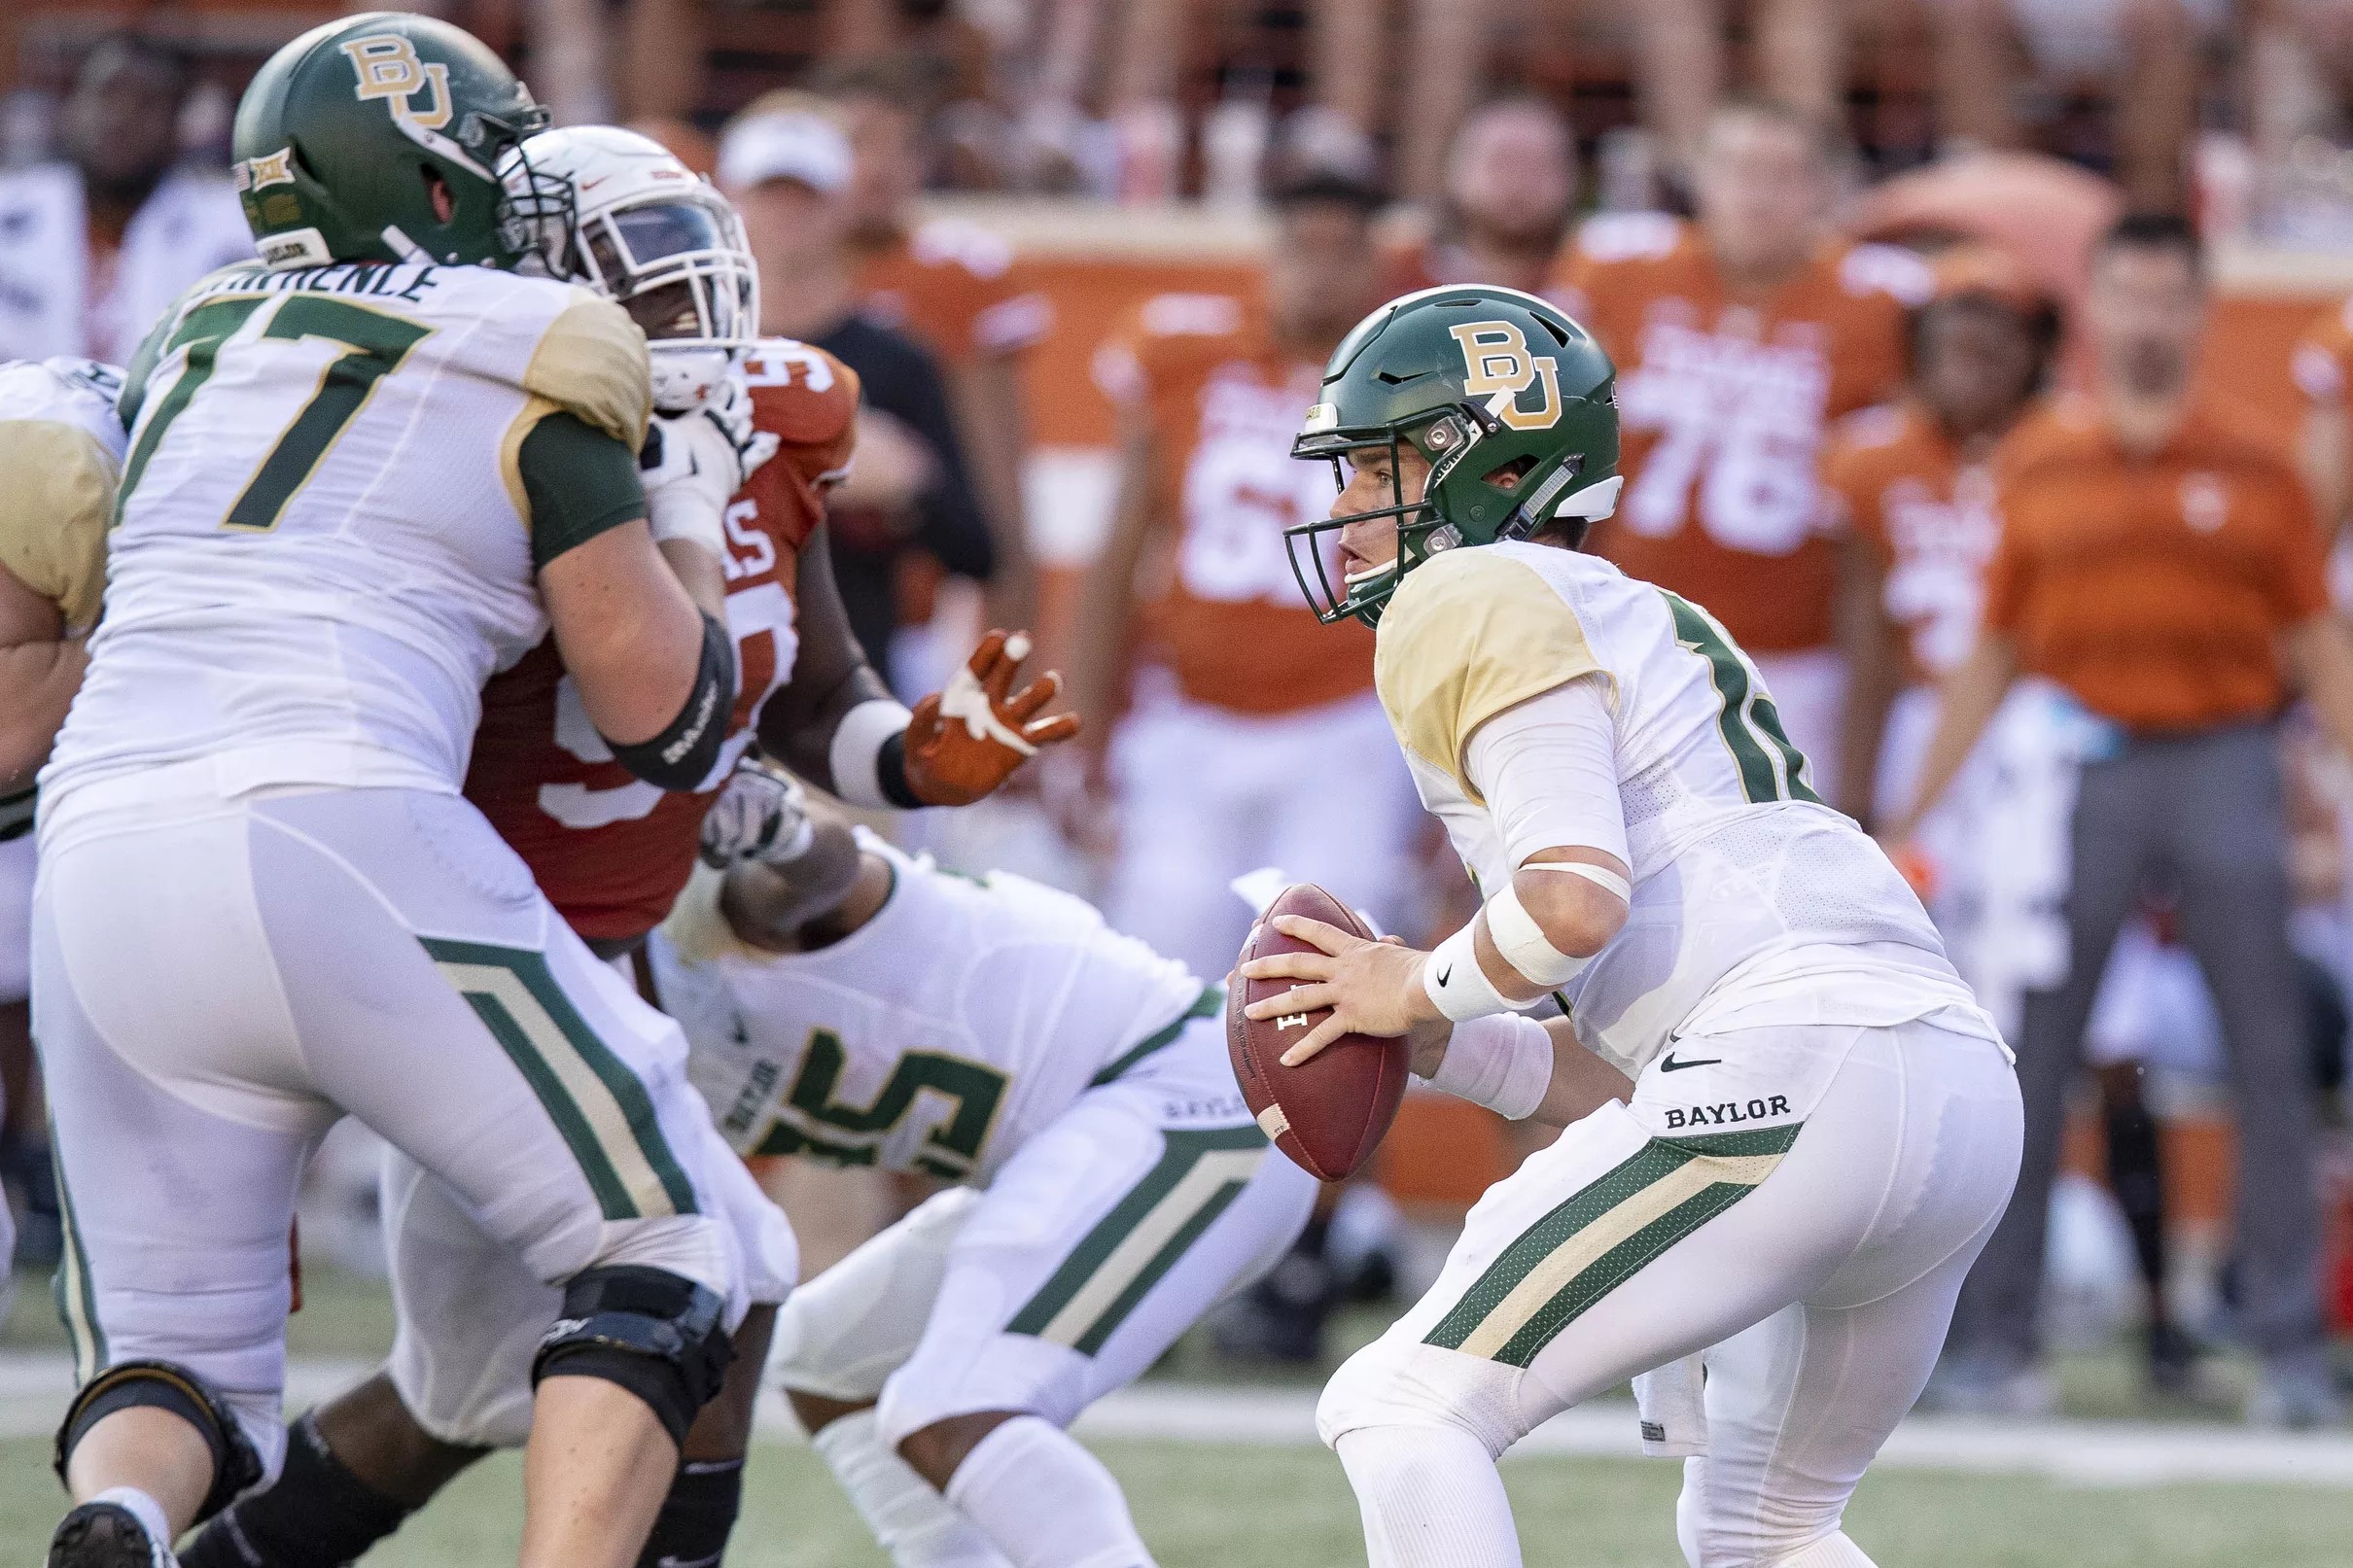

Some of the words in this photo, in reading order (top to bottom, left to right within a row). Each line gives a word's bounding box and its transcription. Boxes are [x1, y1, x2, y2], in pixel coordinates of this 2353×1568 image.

[338, 33, 453, 130] BU
[108, 292, 439, 534] 77
[1449, 320, 1563, 432] BU
[1664, 1094, 1792, 1130] BAYLOR
